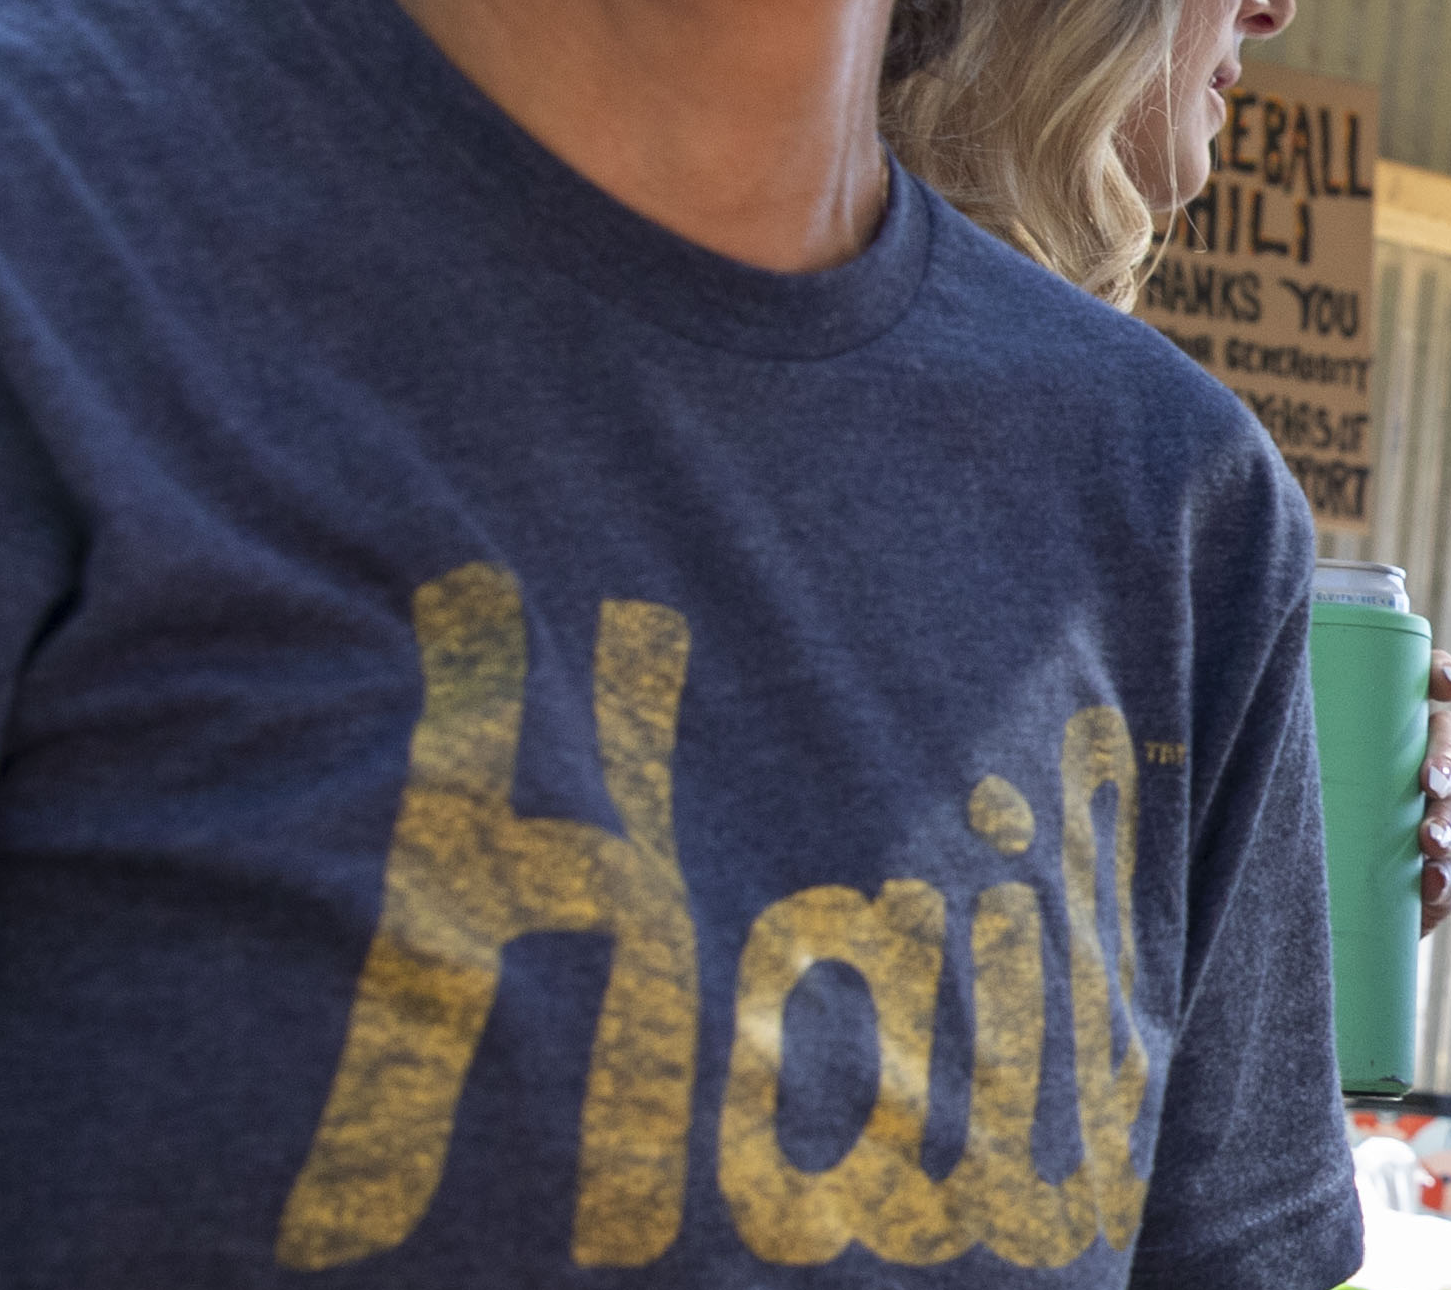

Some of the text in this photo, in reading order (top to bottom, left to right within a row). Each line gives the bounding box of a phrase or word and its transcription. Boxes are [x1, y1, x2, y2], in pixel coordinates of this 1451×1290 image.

[1207, 88, 1373, 198] EBALL
[1152, 181, 1311, 266] HILI
[1146, 259, 1360, 339] HANKS YOU
[272, 559, 1155, 1270] Hail
